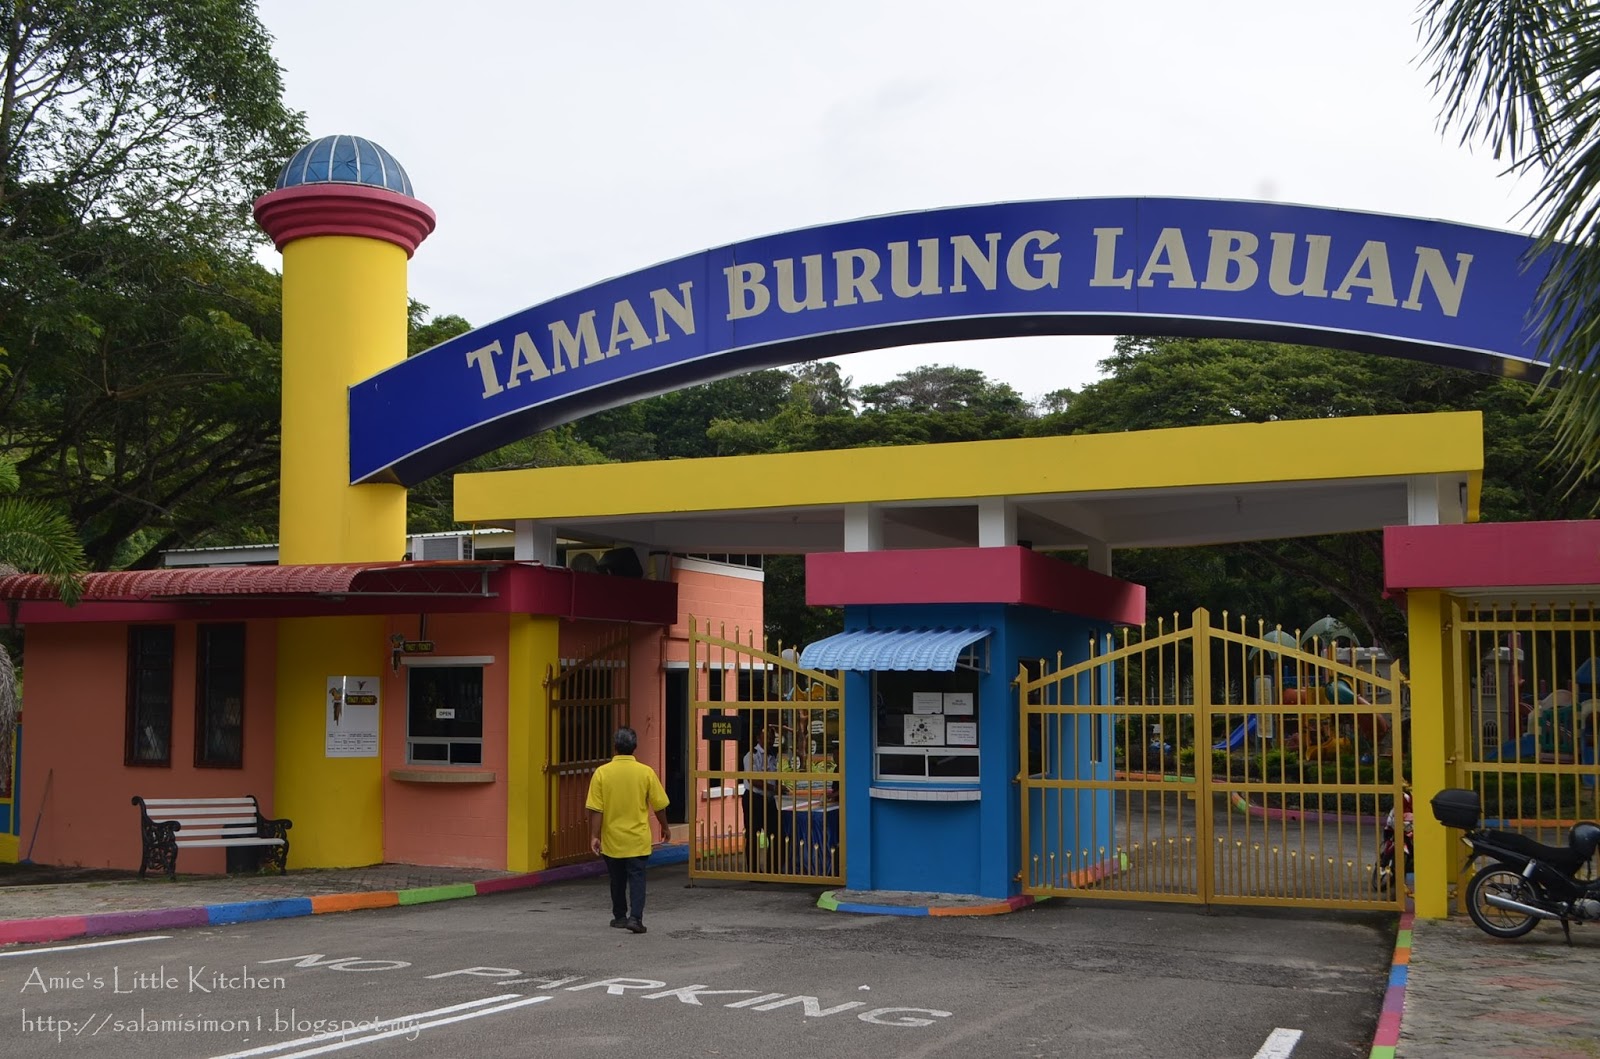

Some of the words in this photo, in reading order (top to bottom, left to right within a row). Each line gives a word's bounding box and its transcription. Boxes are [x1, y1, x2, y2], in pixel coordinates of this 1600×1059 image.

[465, 281, 696, 399] TAMAN
[723, 229, 1062, 321] BURUNG
[1089, 226, 1474, 317] LABUAN
[258, 954, 412, 972] NO
